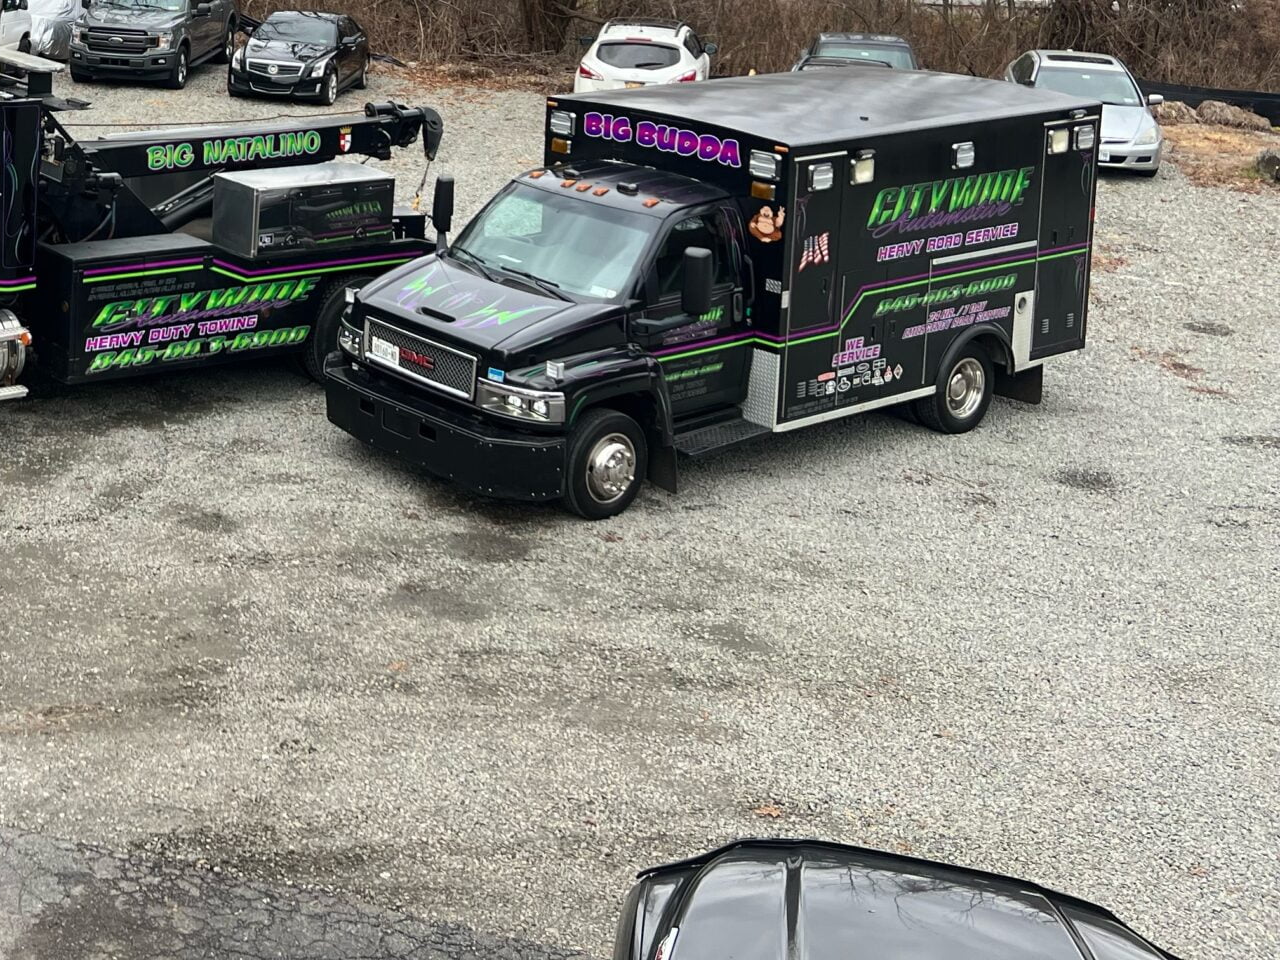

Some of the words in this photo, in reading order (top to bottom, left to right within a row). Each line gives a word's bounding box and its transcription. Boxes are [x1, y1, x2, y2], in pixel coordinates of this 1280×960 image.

[146, 142, 195, 171] BIG
[203, 130, 322, 165] NATALINO
[584, 112, 632, 142] BIG
[636, 121, 742, 168] BUDDA
[867, 166, 1035, 230] CITYWIDE
[873, 199, 1012, 239] Automotive
[877, 240, 924, 262] HEAVY
[926, 233, 963, 253] ROAD
[966, 222, 1019, 246] SERVICE
[92, 276, 321, 329] CITYWIDE
[101, 298, 293, 333] Automotive
[84, 329, 146, 353] HEAVY
[148, 323, 195, 344] DUTY
[197, 315, 259, 337] TOWING
[845, 336, 865, 351] WE
[400, 346, 434, 369] GMC
[832, 344, 881, 368] SERVICE
